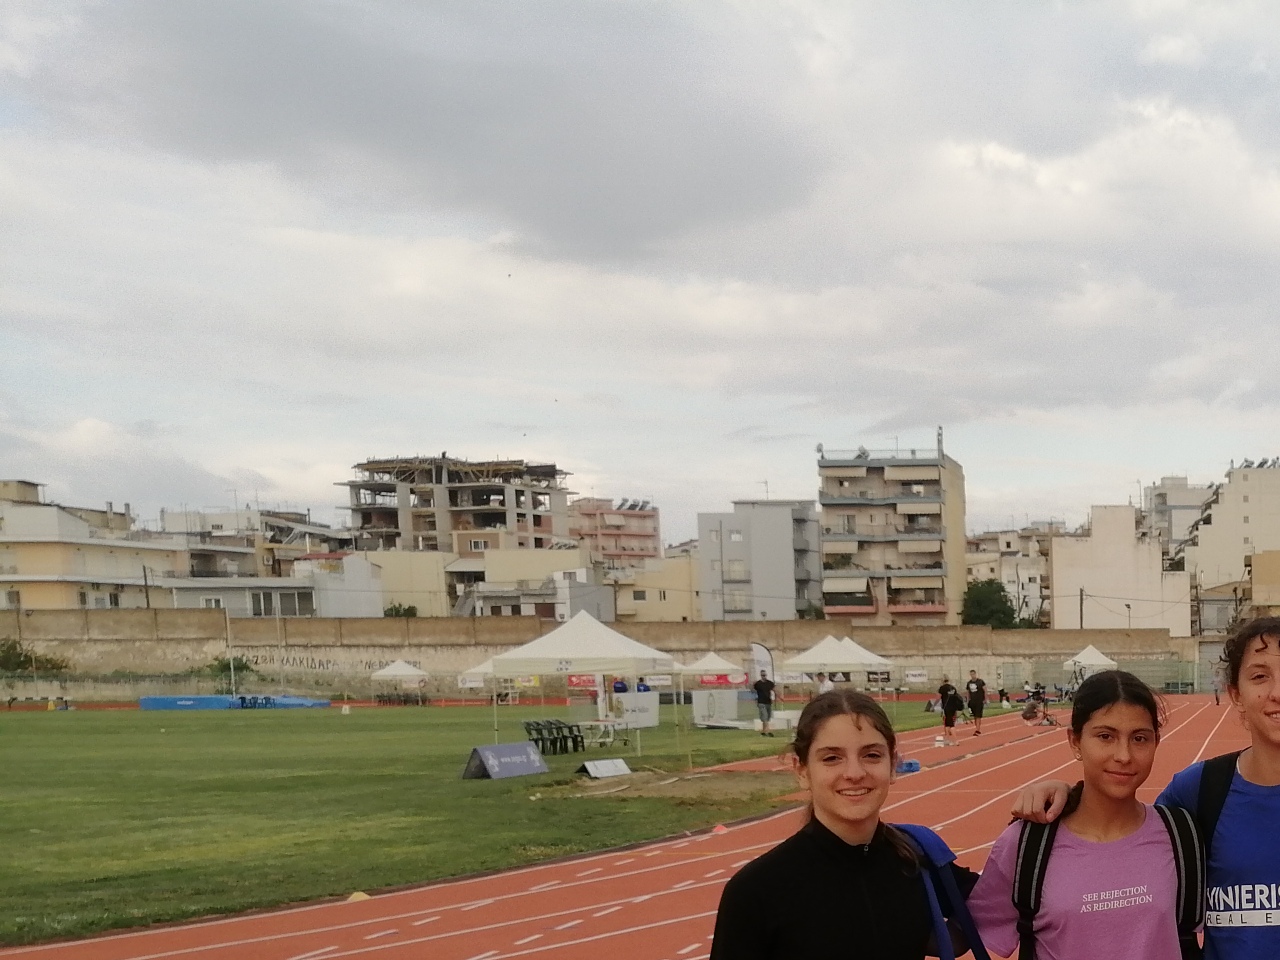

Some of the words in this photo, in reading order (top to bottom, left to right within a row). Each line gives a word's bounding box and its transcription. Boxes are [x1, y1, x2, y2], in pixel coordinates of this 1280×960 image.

[1082, 893, 1099, 902] SEE
[1100, 885, 1147, 900] REJECTION
[1080, 904, 1092, 913] AS
[1093, 895, 1153, 911] REDIRECTION
[1206, 913, 1247, 925] REAL
